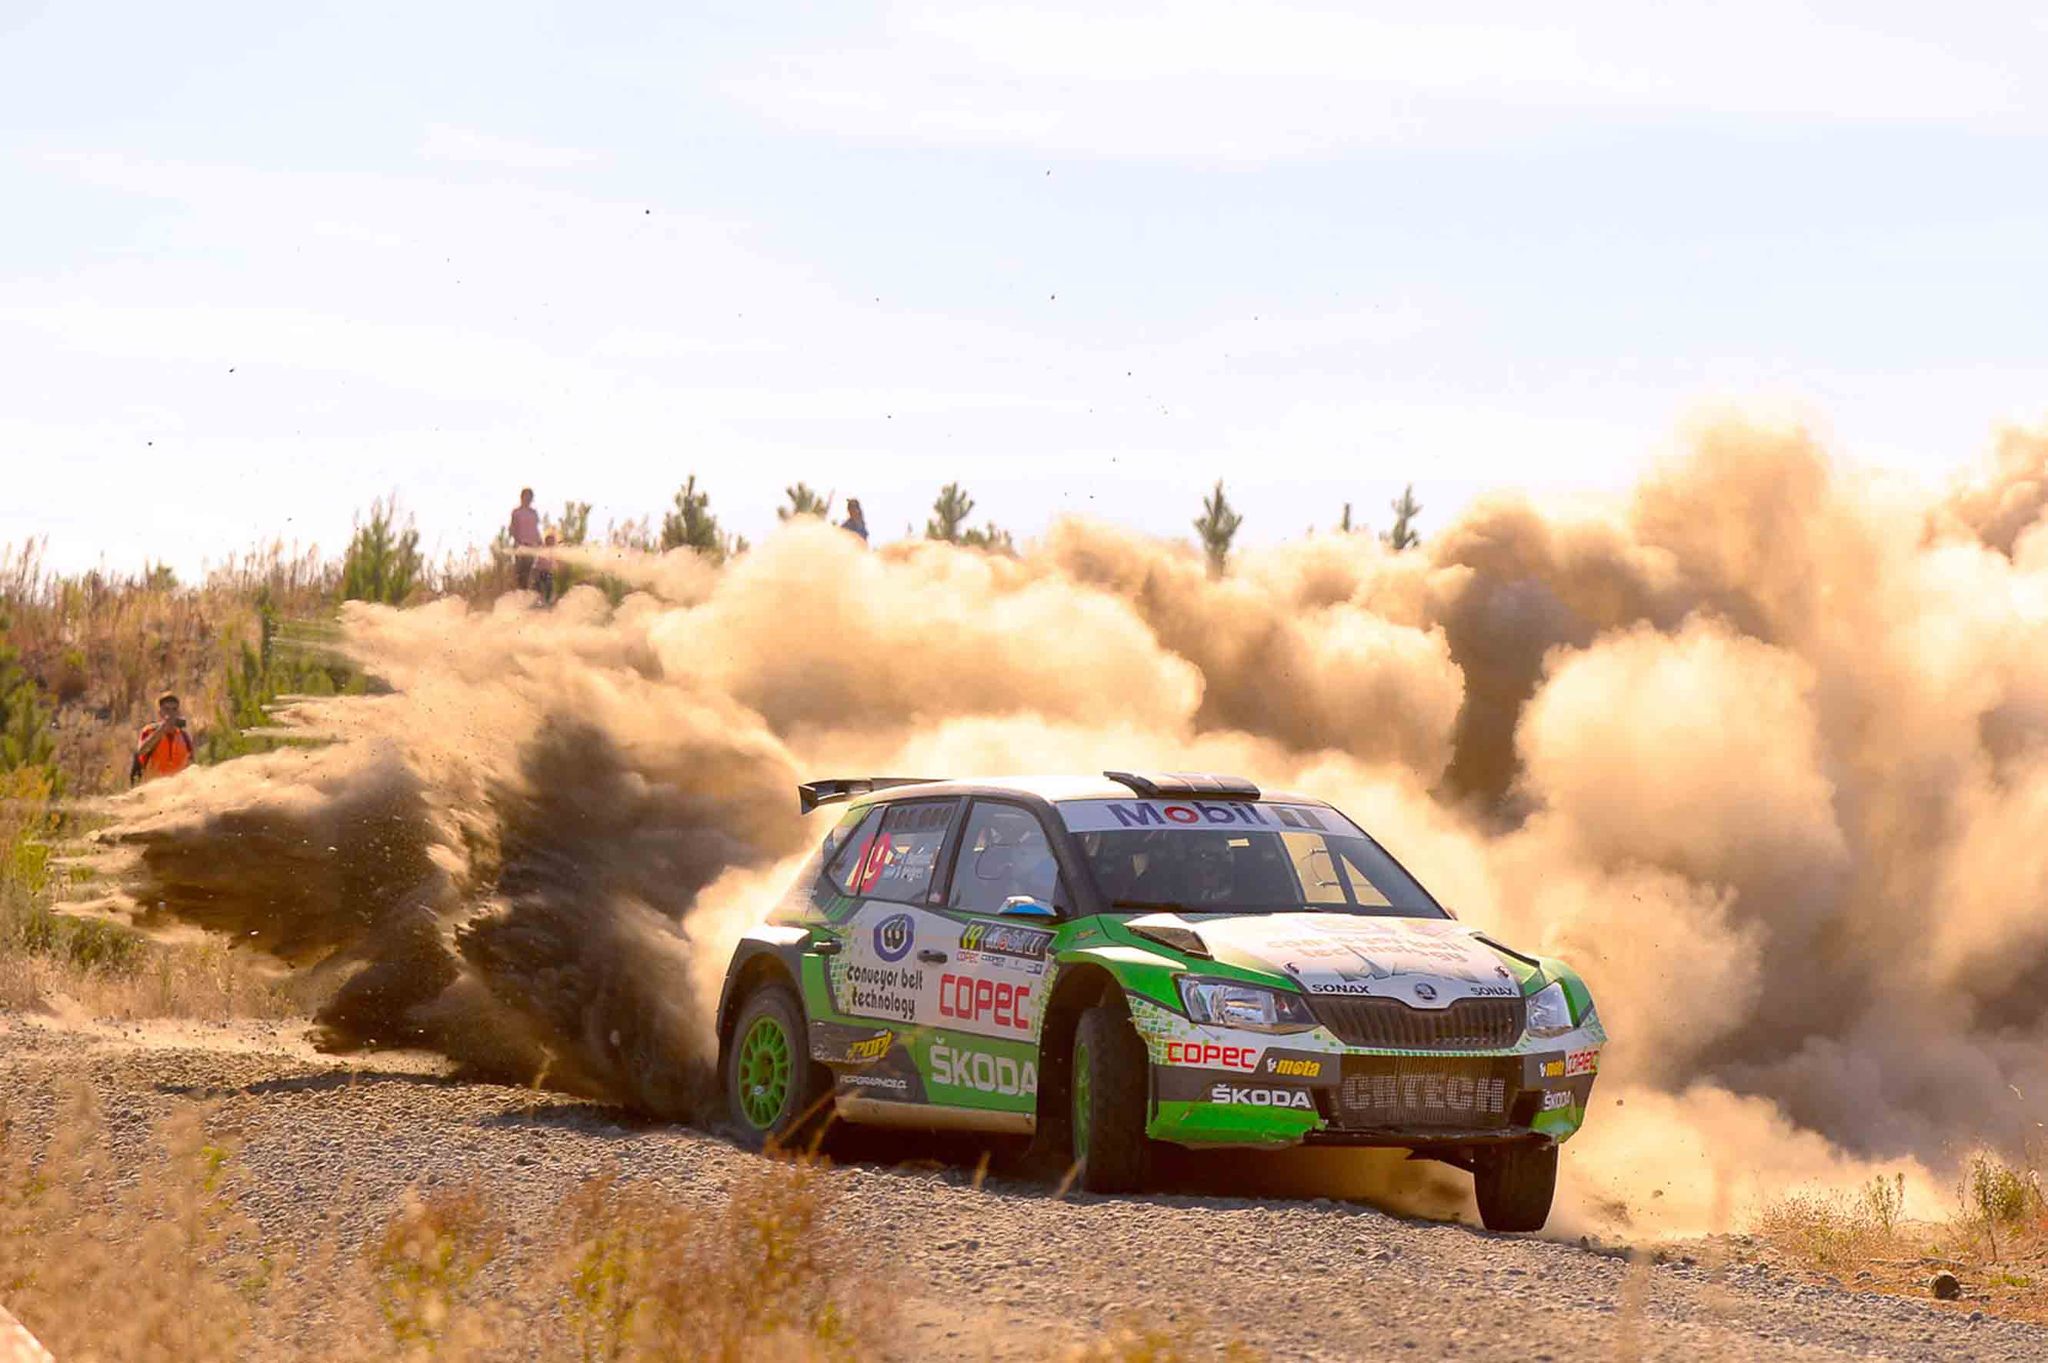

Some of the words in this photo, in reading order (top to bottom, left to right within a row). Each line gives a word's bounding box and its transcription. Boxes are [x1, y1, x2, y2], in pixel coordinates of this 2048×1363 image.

[1106, 801, 1269, 827] Mobil
[844, 832, 892, 893] 19
[847, 965, 898, 991] conveyor
[902, 967, 923, 991] belt
[1311, 983, 1371, 995] SONAX
[1470, 984, 1517, 996] SONAX
[852, 986, 916, 1020] technology
[940, 973, 1031, 1030] COPEC
[929, 1035, 1039, 1097] ŠKODA
[1167, 1042, 1257, 1069] COPEC
[1210, 1083, 1313, 1109] ŠKODA
